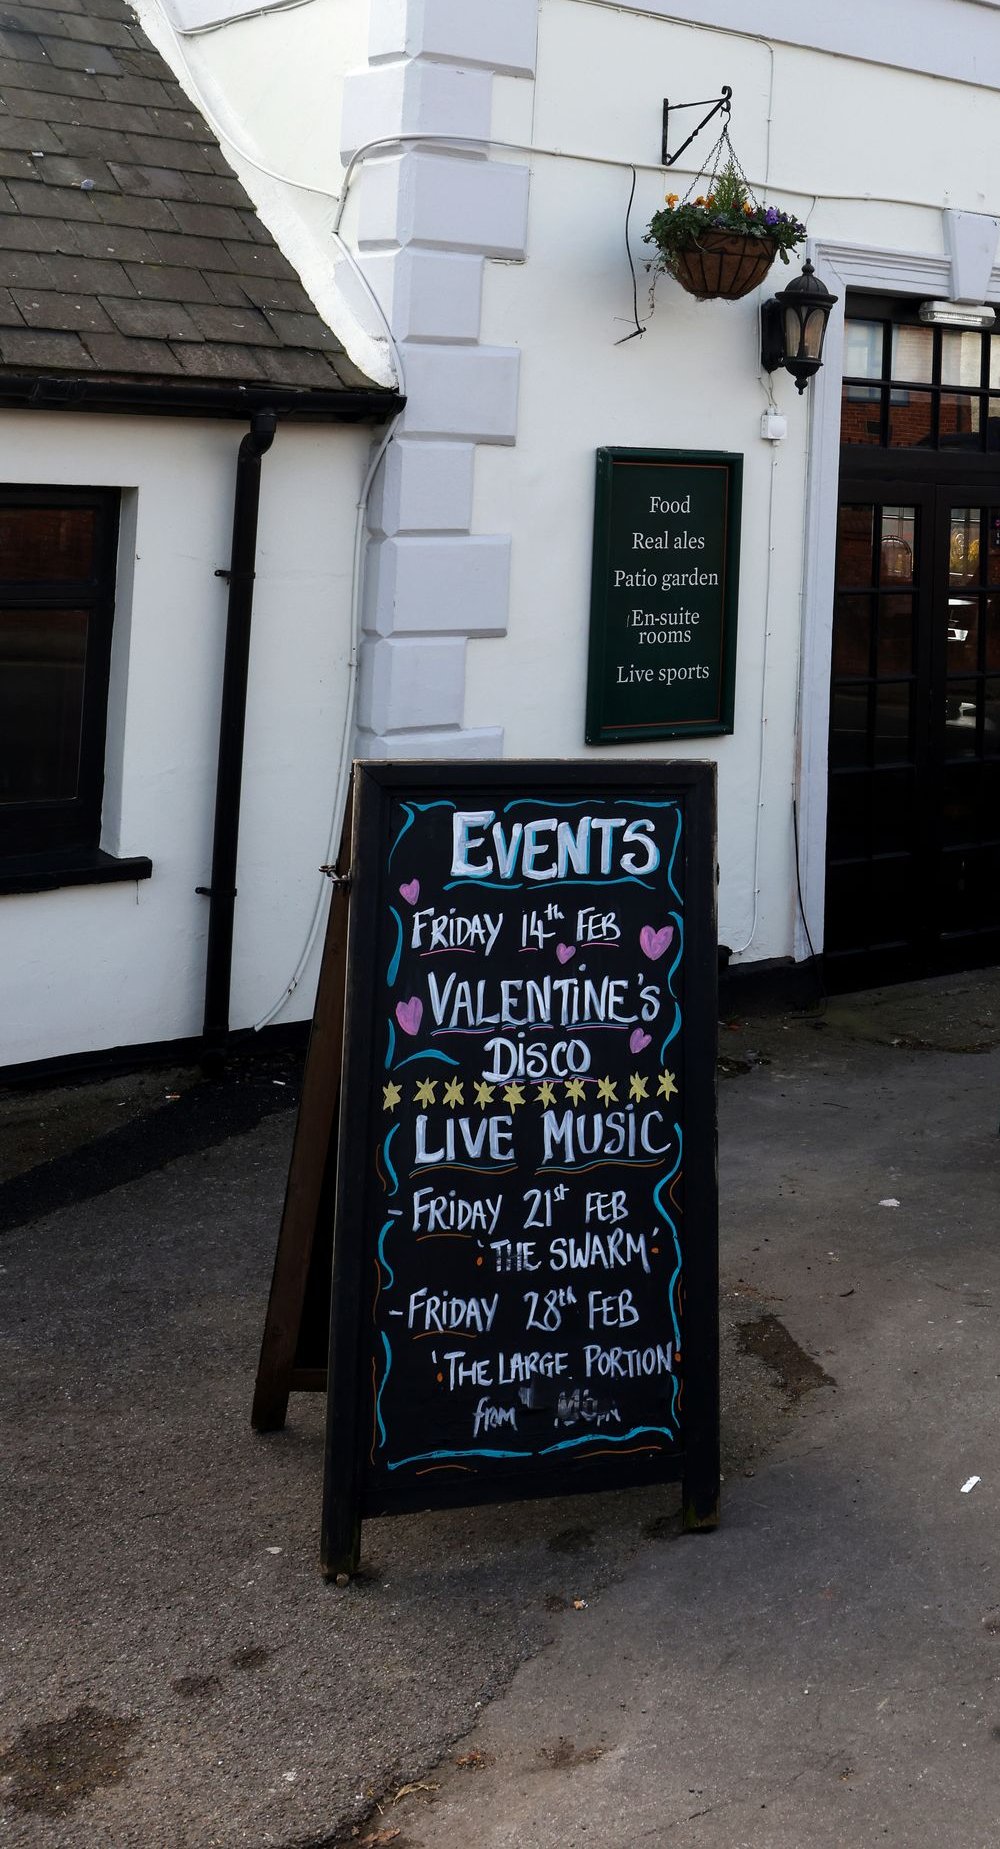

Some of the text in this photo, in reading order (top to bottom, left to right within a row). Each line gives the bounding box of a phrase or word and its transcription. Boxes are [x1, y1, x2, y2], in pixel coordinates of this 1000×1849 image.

[649, 495, 691, 514] Food
[632, 530, 705, 550] Real ales
[613, 567, 719, 592] Patio garden
[631, 606, 700, 628] En-suite
[638, 629, 691, 645] rooms
[616, 663, 710, 686] Live sports
[451, 811, 660, 880] EVENTS
[411, 904, 620, 956] FRIDAY 14th FEB
[482, 1032, 591, 1083] DISCO
[414, 1104, 671, 1164] LIVE MUSIC
[523, 1184, 569, 1229] 21st
[585, 1190, 628, 1224] FEB
[523, 1286, 577, 1331] 28th
[588, 1290, 639, 1330] FEB
[499, 1352, 569, 1384] LARGE
[473, 1395, 518, 1438] from
